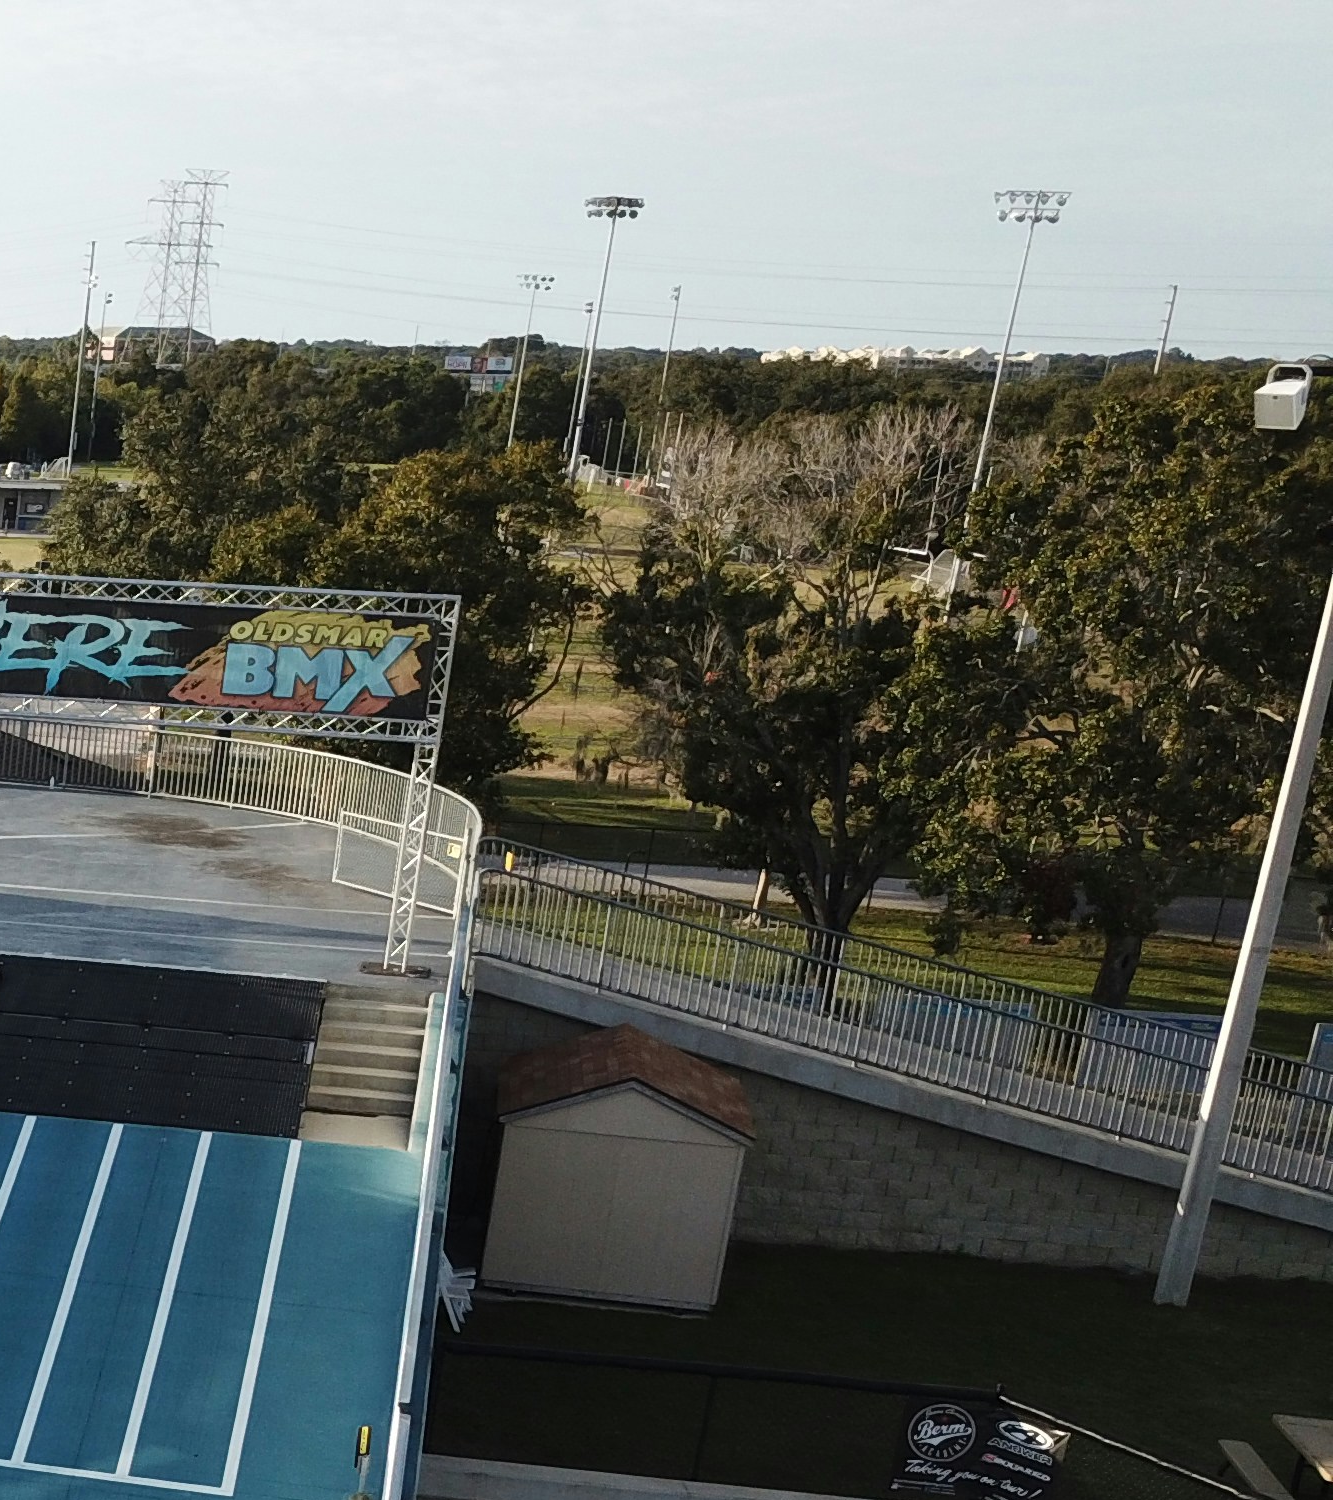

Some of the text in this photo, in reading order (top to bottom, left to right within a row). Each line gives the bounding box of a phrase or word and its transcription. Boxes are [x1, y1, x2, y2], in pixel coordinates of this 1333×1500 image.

[229, 620, 390, 649] OLDSMAR
[221, 635, 417, 714] BMX
[913, 1419, 968, 1440] Berm
[904, 1459, 953, 1482] Taking
